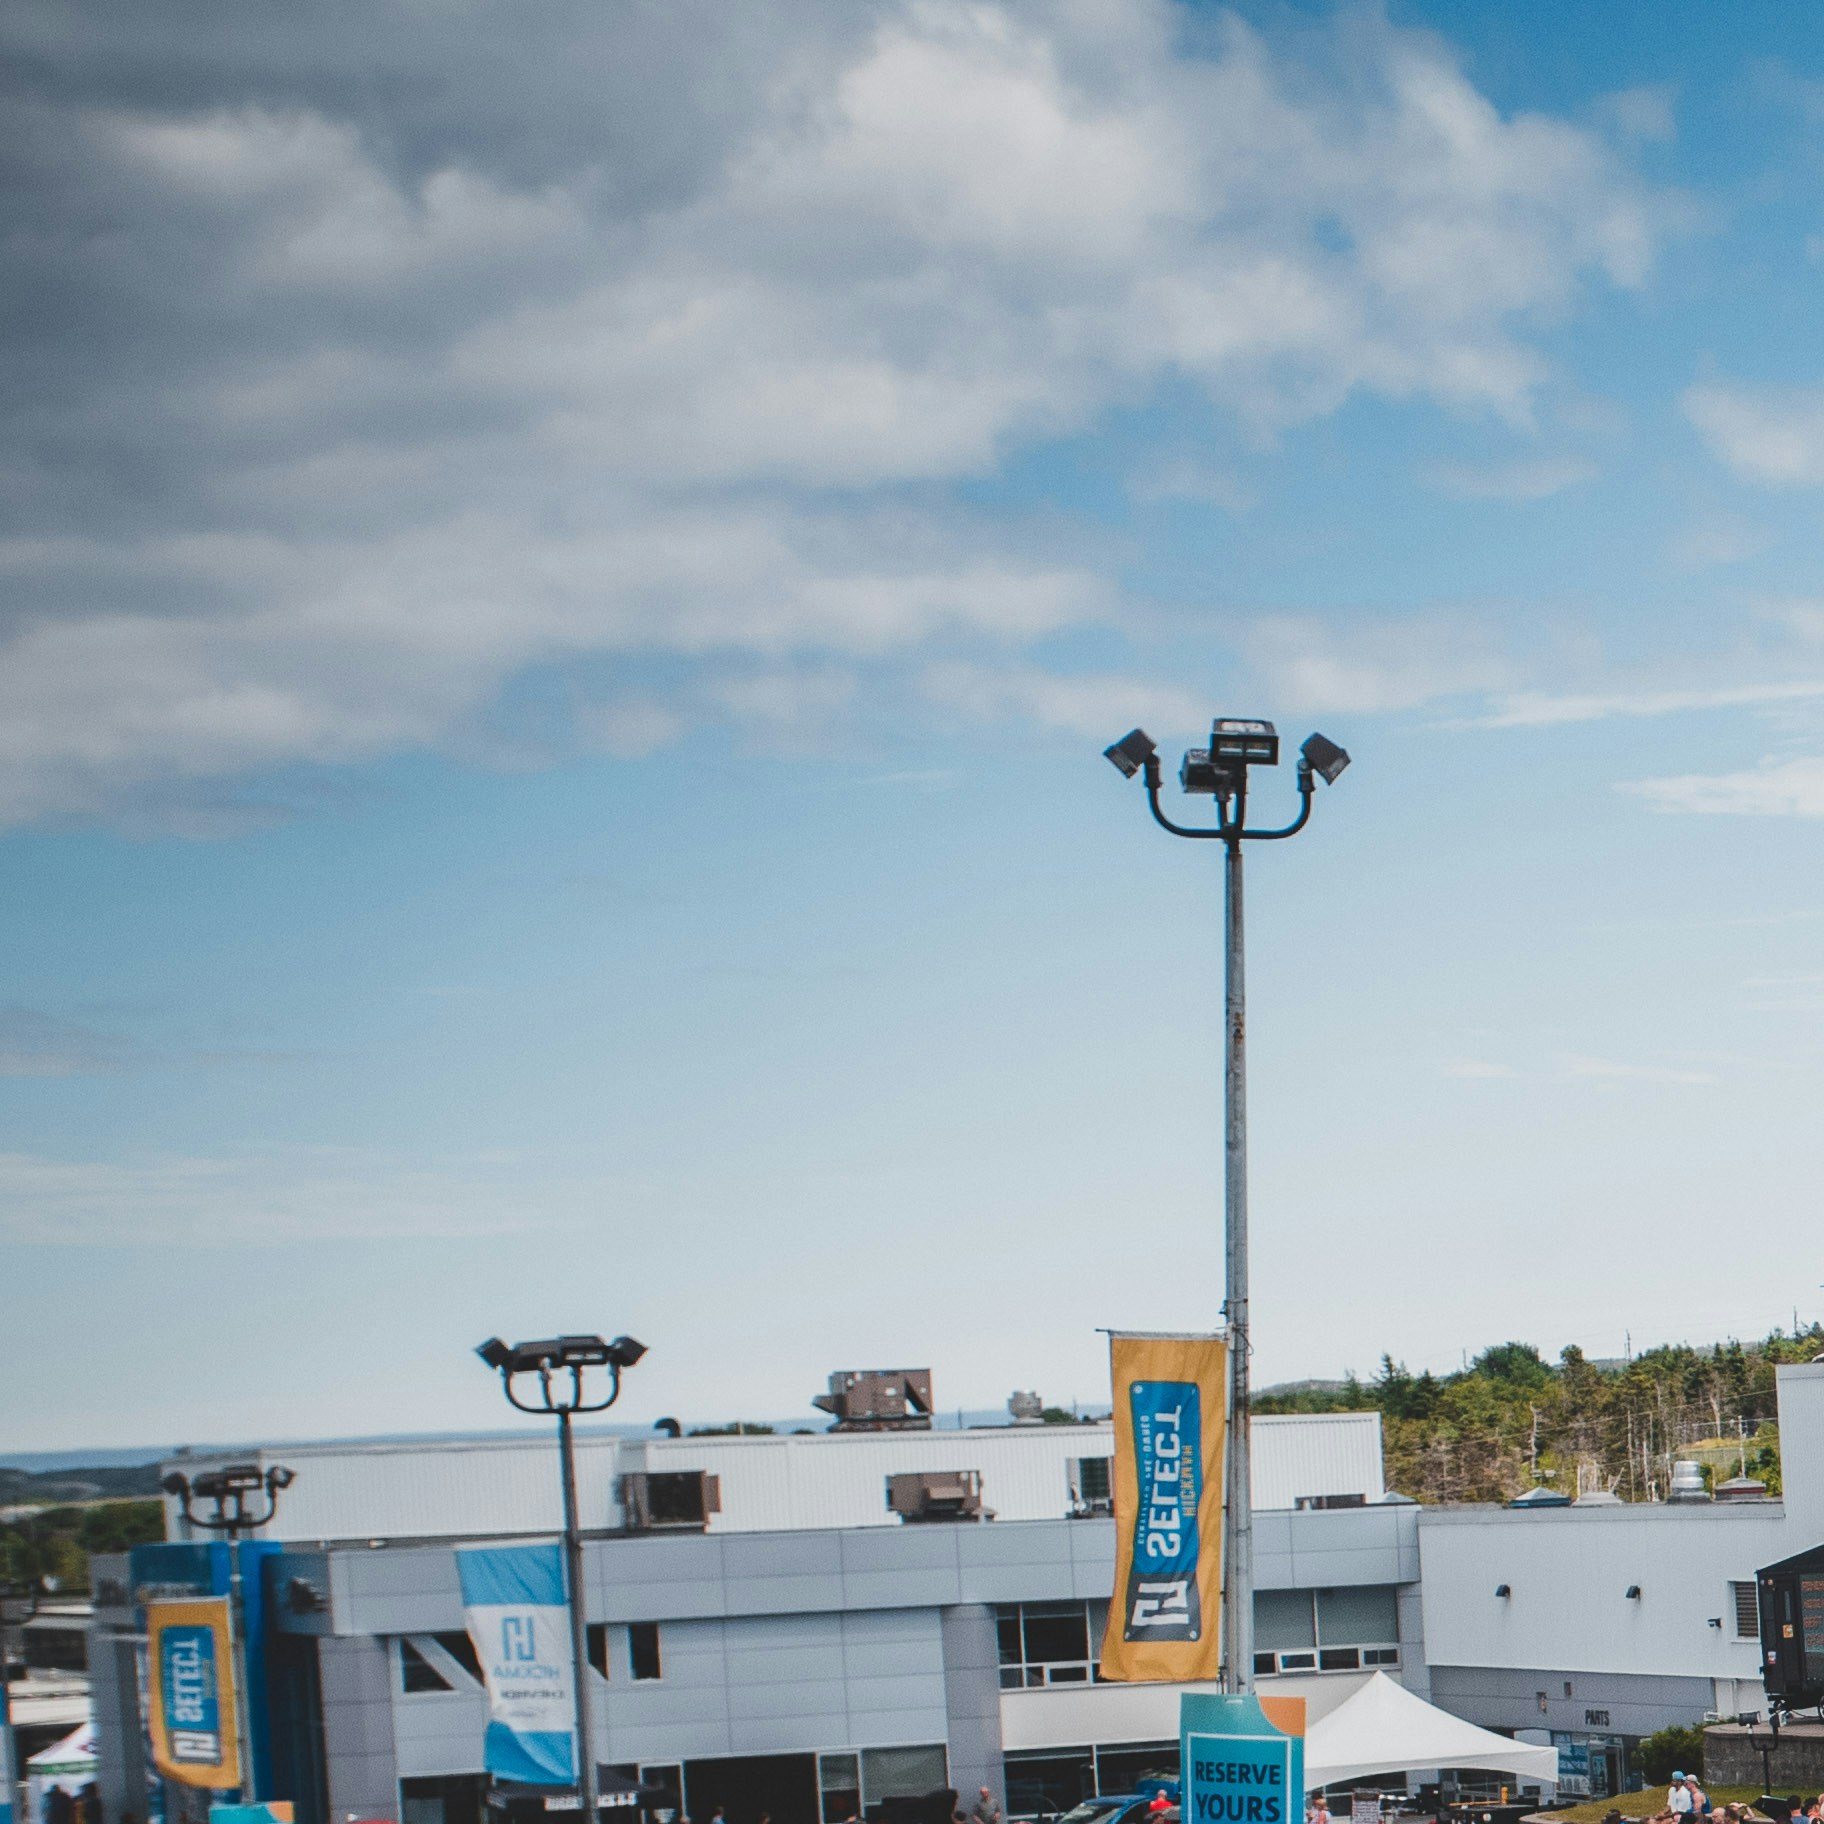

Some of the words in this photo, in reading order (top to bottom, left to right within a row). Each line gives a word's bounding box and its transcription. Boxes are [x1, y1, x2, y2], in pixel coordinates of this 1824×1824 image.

[1585, 1709, 1610, 1727] PARTS
[1195, 1761, 1281, 1785] RESERVE
[1195, 1793, 1280, 1823] YOURS
